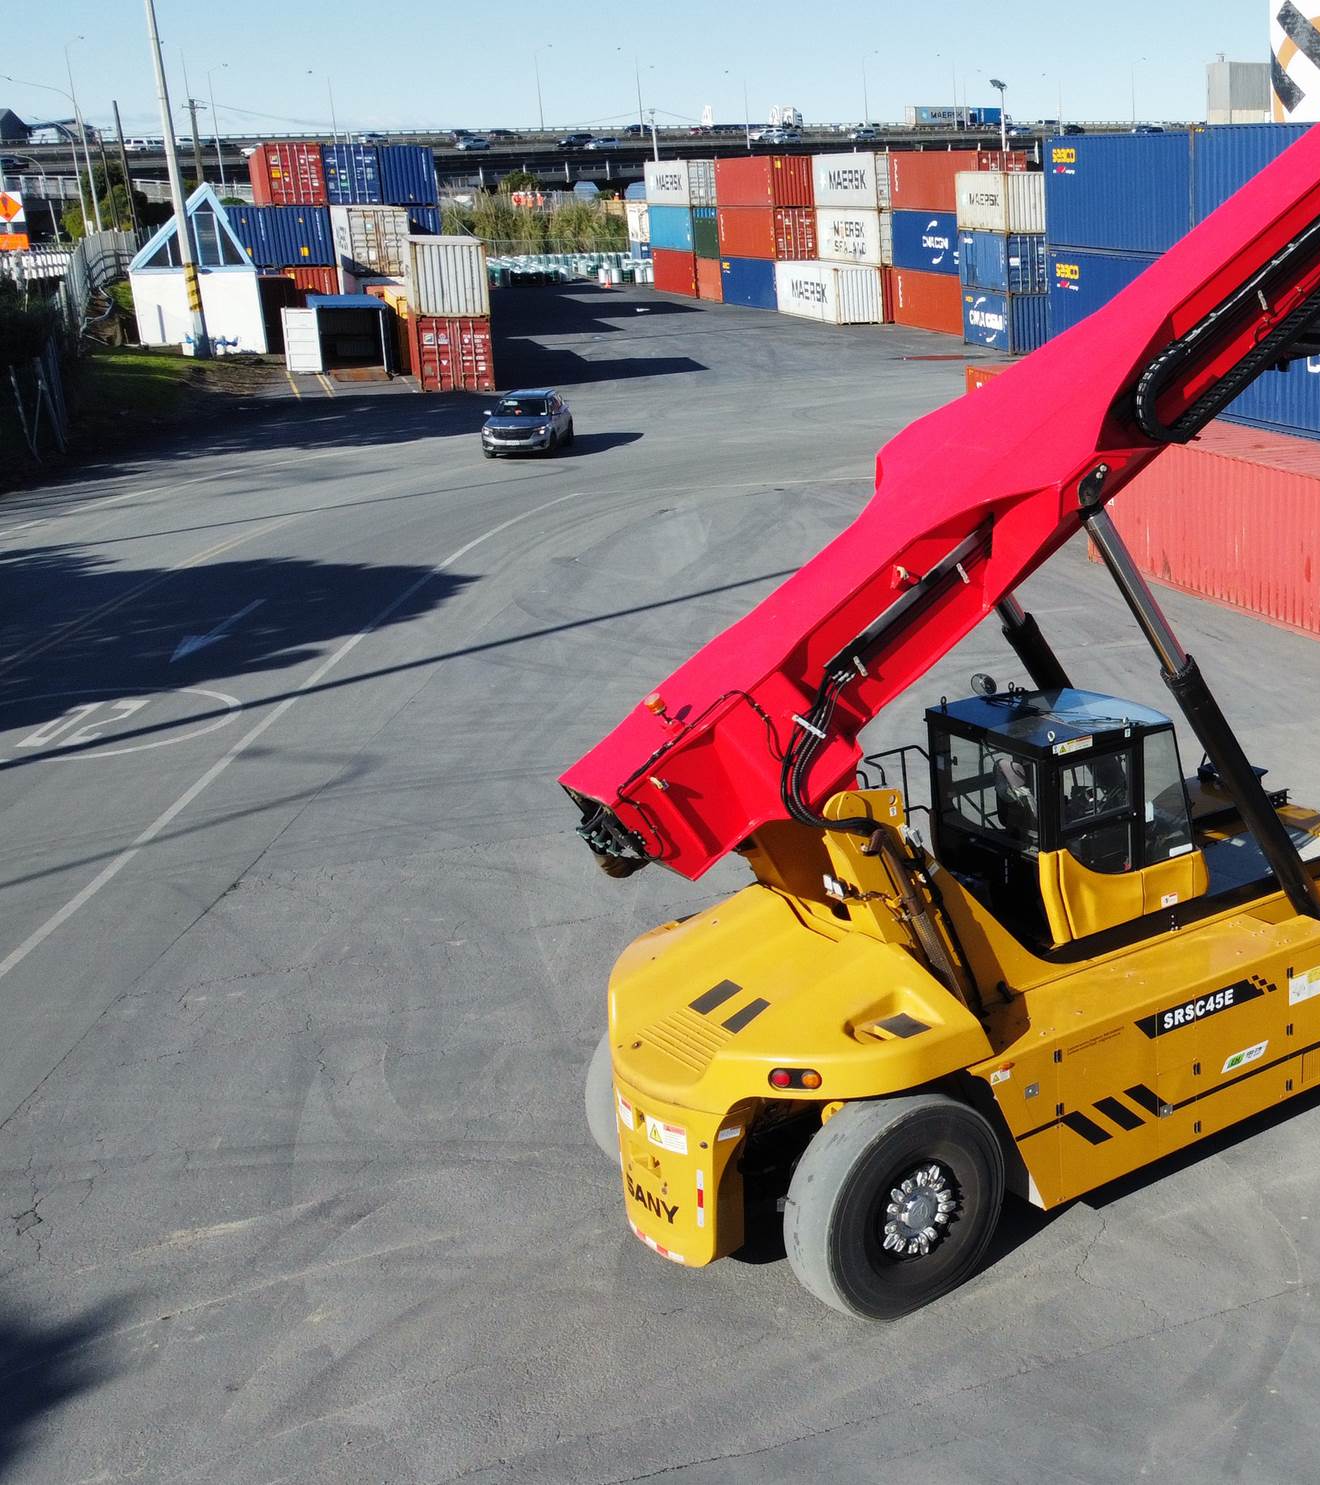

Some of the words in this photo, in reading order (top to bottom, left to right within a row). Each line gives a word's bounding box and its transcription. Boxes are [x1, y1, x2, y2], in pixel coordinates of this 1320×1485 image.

[656, 174, 683, 191] MAERSK
[828, 169, 867, 190] MAERSK
[791, 279, 829, 304] MAERSK
[1163, 988, 1234, 1030] SRSC45E
[625, 1171, 679, 1225] SANY
